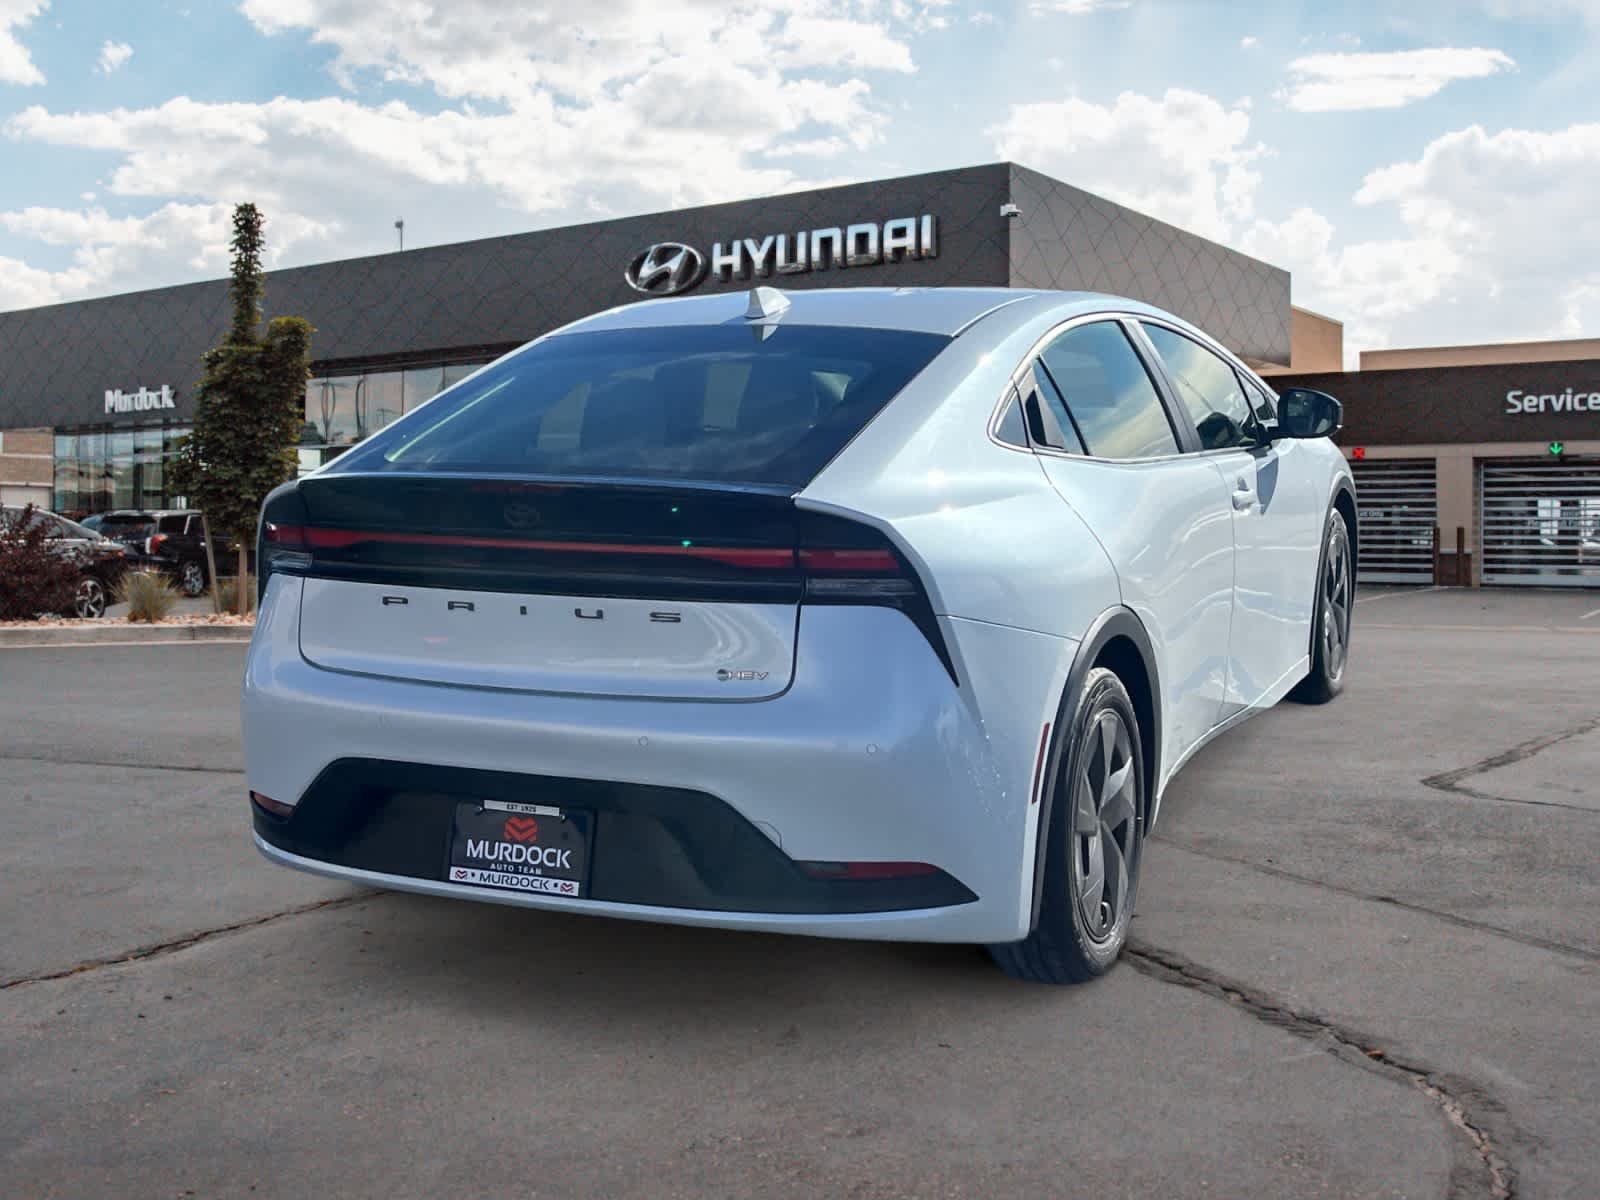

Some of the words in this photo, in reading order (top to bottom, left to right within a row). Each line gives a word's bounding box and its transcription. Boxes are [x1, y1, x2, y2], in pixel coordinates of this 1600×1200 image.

[711, 213, 936, 283] HYUNDAI
[104, 384, 176, 414] Murdock
[1505, 387, 1600, 414] Service
[382, 596, 682, 623] PRIUS
[466, 838, 572, 869] MURDOCK
[479, 871, 550, 891] MURDOCK
[489, 863, 514, 873] AUTO
[519, 866, 542, 876] TEAM
